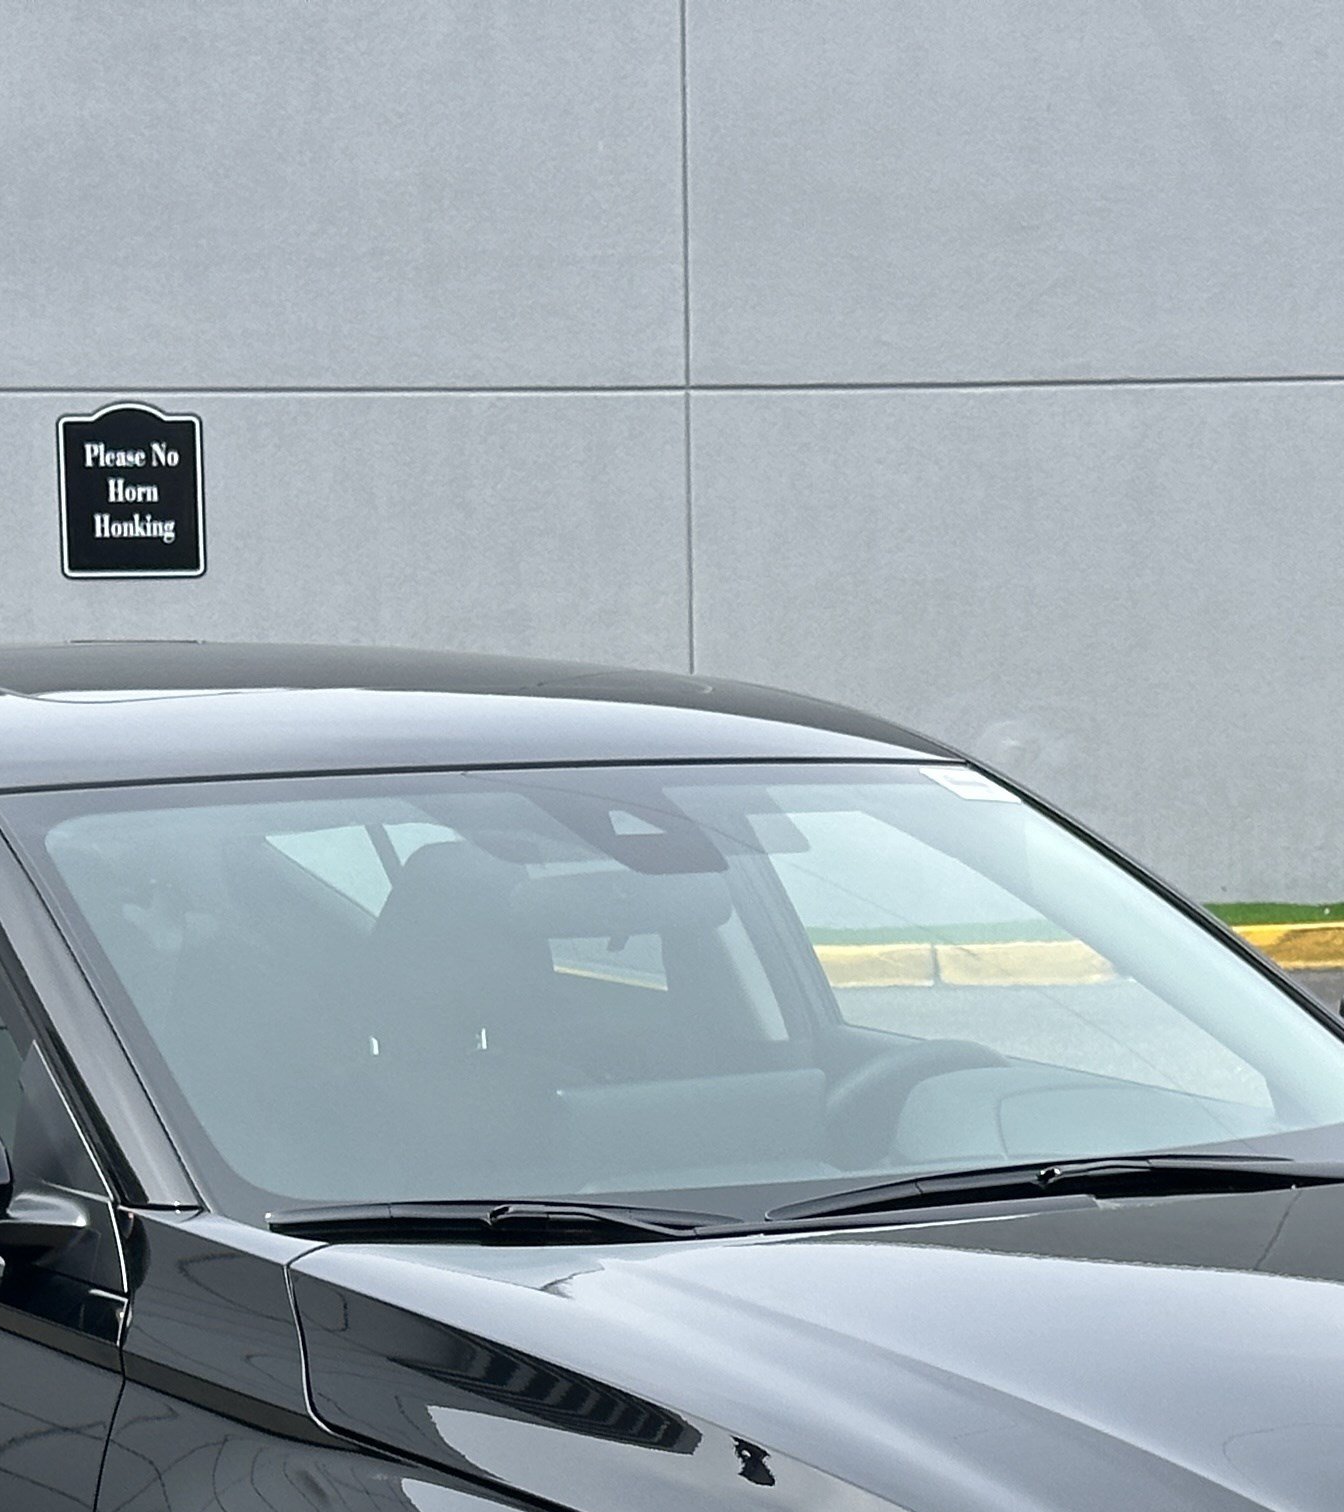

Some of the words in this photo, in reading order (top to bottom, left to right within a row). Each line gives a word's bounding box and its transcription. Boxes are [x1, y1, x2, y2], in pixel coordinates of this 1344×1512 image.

[84, 442, 146, 467] Please
[150, 441, 179, 467] No
[108, 477, 159, 503] Horn
[94, 513, 175, 544] Honking
